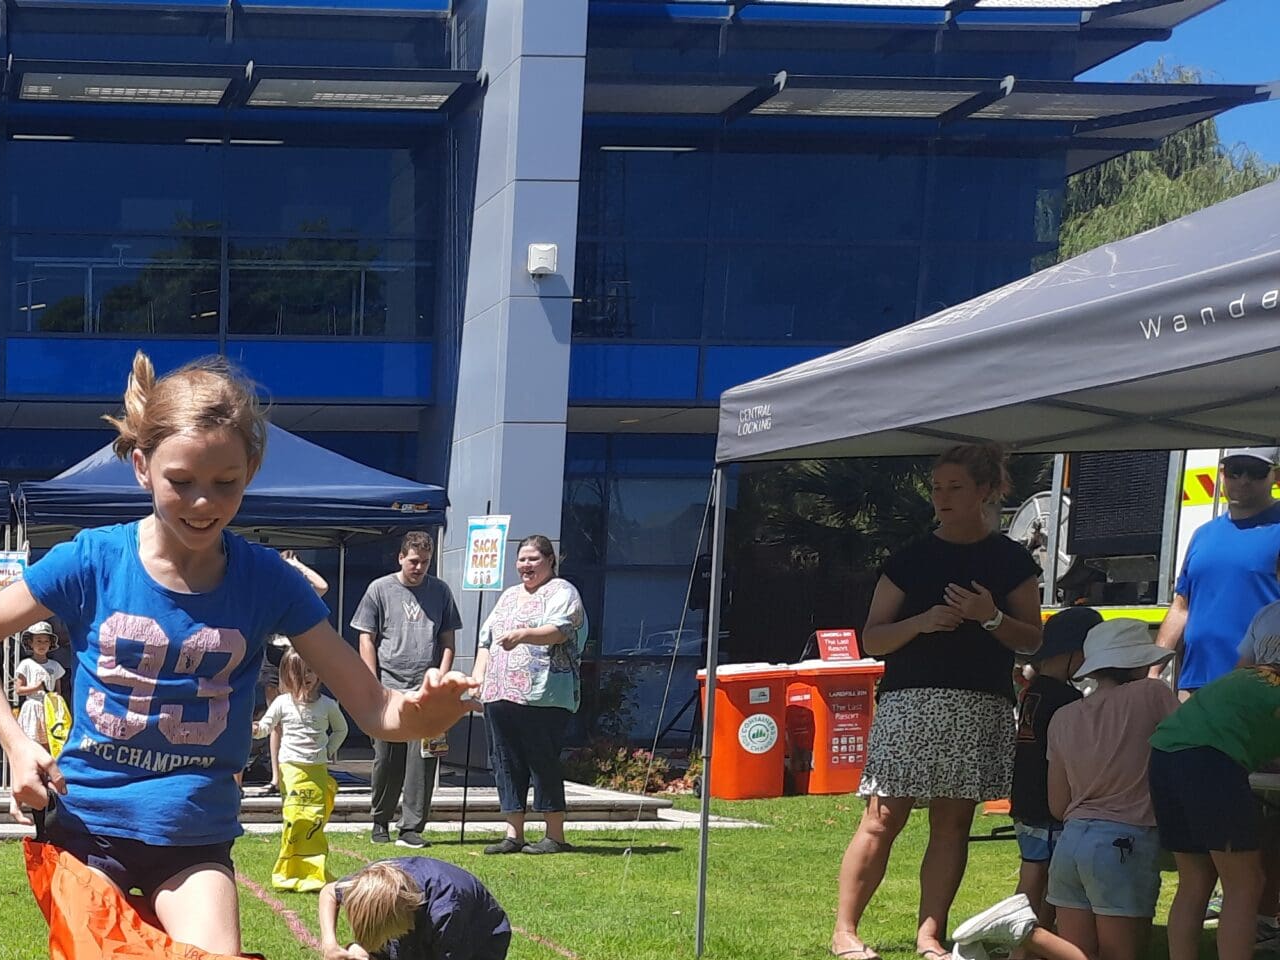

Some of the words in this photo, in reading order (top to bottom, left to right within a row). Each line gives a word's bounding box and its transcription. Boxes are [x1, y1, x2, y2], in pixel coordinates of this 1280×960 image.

[1139, 289, 1279, 339] Wande
[739, 404, 772, 423] CENTRAL
[737, 417, 772, 437] LOCKING
[472, 538, 499, 553] SACK
[471, 554, 498, 569] RACE
[85, 611, 248, 746] 93
[832, 704, 846, 712] The
[847, 703, 863, 711] Last
[834, 712, 859, 721] Resort
